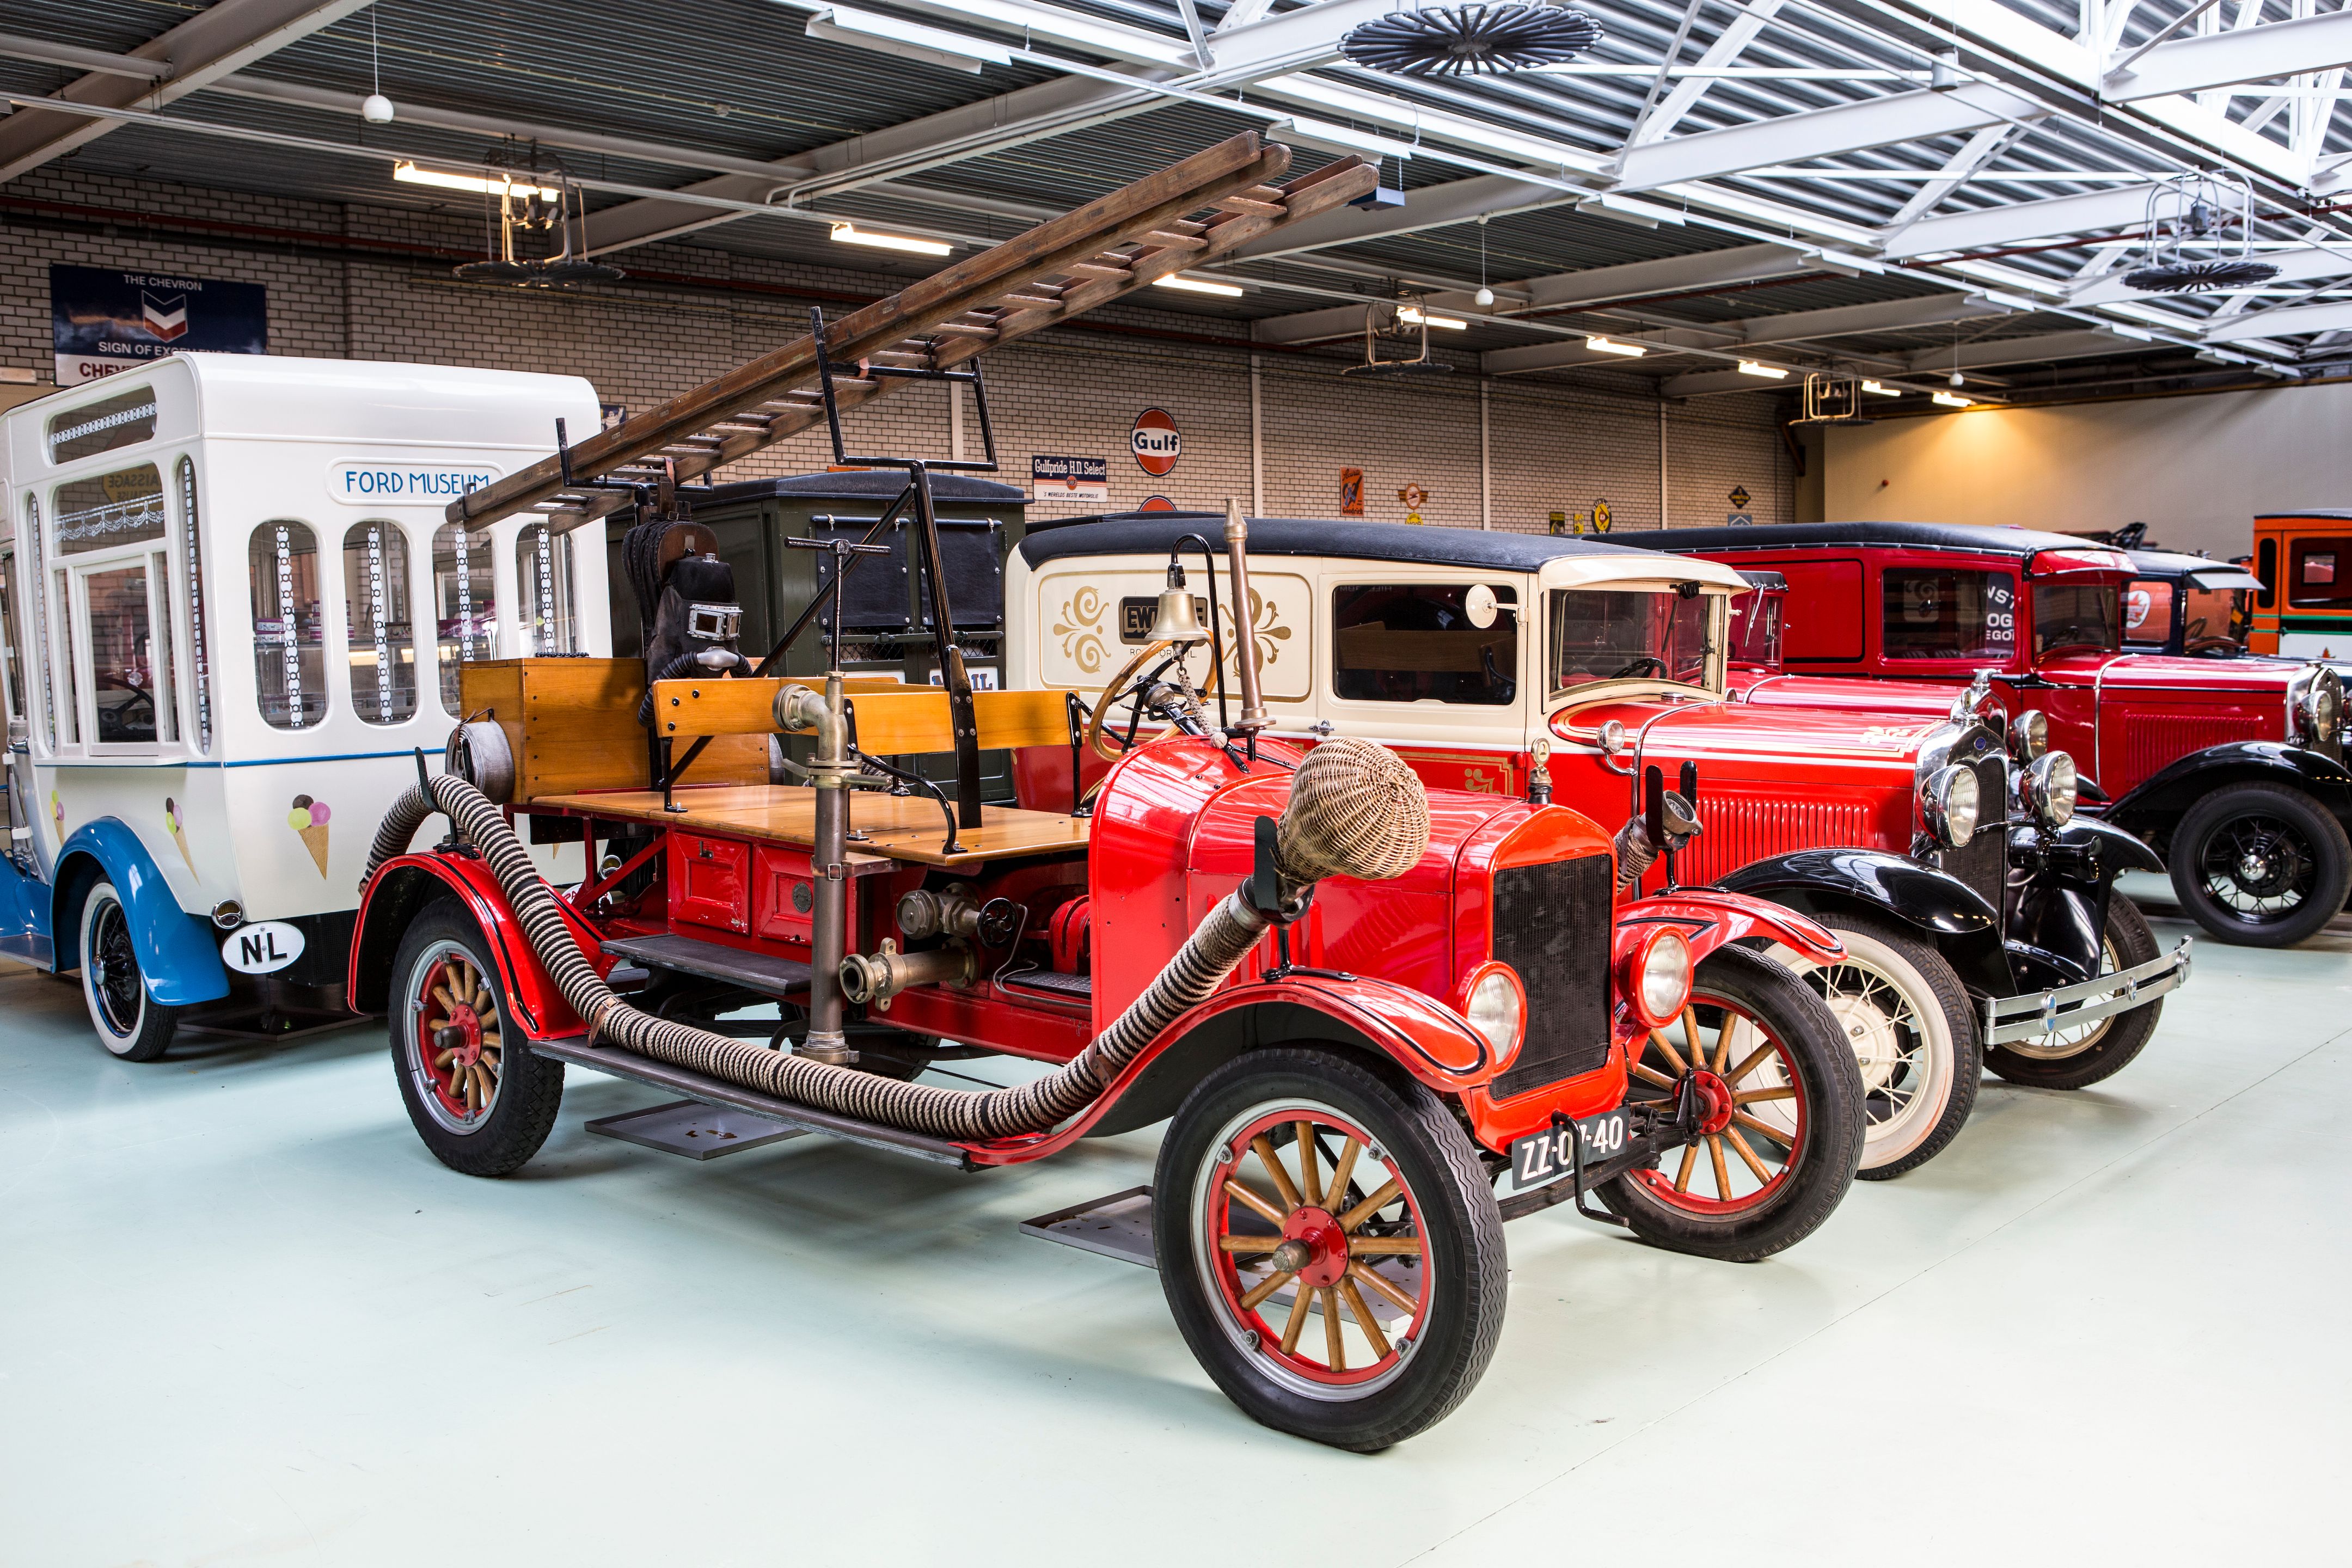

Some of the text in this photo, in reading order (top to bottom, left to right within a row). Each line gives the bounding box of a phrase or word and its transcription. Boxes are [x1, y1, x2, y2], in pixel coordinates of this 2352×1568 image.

[124, 274, 203, 291] THE CHEVRON
[98, 341, 132, 354] SIGN
[134, 344, 152, 356] OF
[1134, 431, 1178, 451] Gulf
[1034, 458, 1068, 476] Gulfpride
[1084, 462, 1106, 476] Select
[346, 471, 489, 494] FORD MUSEUM
[240, 932, 287, 966] NL
